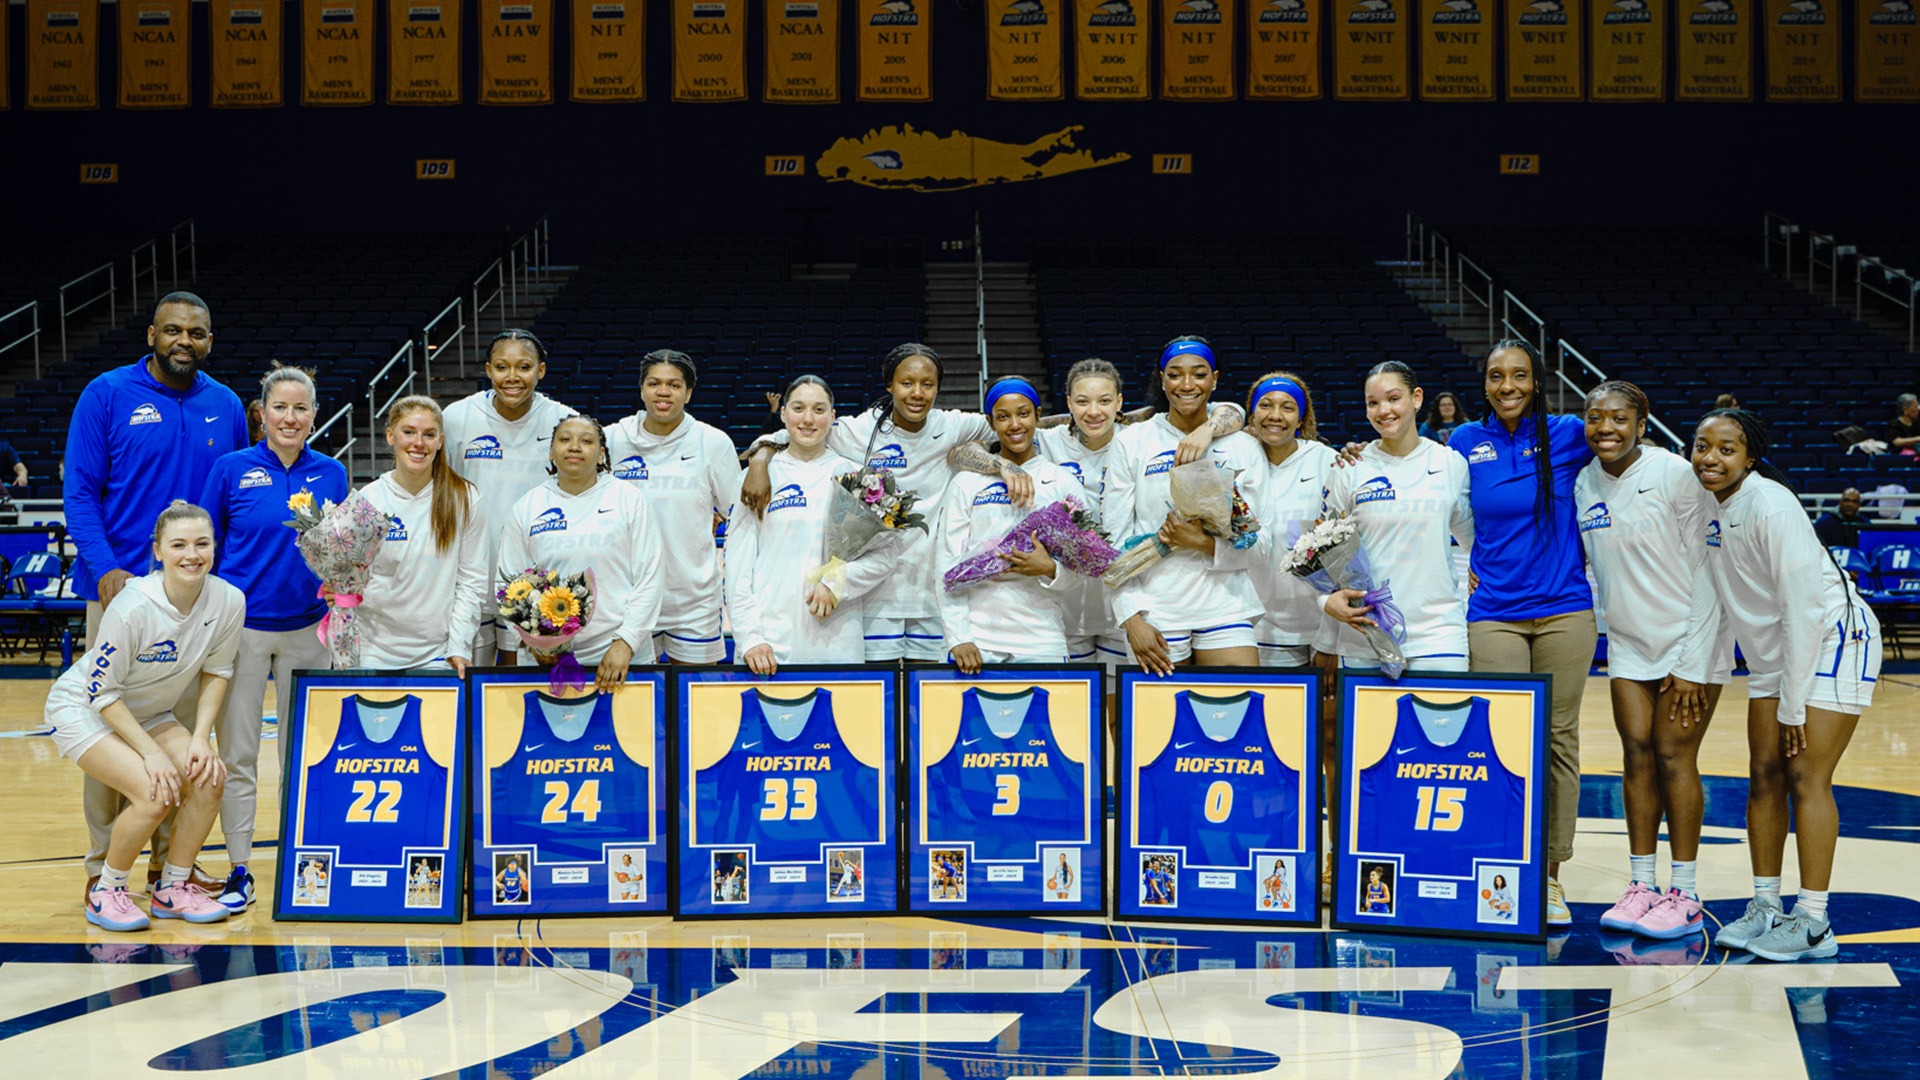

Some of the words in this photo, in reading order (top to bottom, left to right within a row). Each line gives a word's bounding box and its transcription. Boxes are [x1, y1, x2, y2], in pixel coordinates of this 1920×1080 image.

[872, 14, 917, 23] HOFSTRA
[1003, 14, 1047, 23] HOFSTRA
[1091, 15, 1135, 23] HOFSTRA
[1176, 12, 1221, 21] HOFSTRA
[1263, 12, 1307, 20] HOFSTRA
[1351, 12, 1396, 21] HOFSTRA
[1435, 12, 1480, 21] HOFSTRA
[1522, 13, 1567, 22] HOFSTRA
[1605, 12, 1650, 21] HOFSTRA
[1692, 12, 1736, 21] HOFSTRA
[1781, 13, 1825, 21] HOFSTRA
[1871, 13, 1916, 21] HOFSTRA
[317, 28, 359, 40] NCAA
[403, 27, 445, 38] NCAA
[492, 25, 540, 37] AIAW
[591, 25, 626, 36] NIT
[688, 23, 731, 34] NCAA
[780, 24, 823, 35] NCAA
[42, 32, 83, 44] NCAA
[133, 32, 175, 43] NCAA
[226, 29, 267, 41] NCAA
[879, 33, 911, 44] NIT
[1010, 32, 1040, 44] NIT
[1089, 33, 1137, 44] WNIT
[1182, 32, 1215, 44] NIT
[1258, 31, 1310, 43] WNIT
[1349, 32, 1395, 43] WNIT
[1435, 32, 1479, 44] WNIT
[1521, 32, 1567, 43] WNIT
[1612, 32, 1644, 44] NIT
[1693, 32, 1739, 44] WNIT
[1787, 33, 1821, 45] NIT
[1877, 33, 1910, 45] NIT
[328, 55, 348, 63] 1976
[698, 54, 723, 62] 2000
[792, 52, 812, 61] 2001
[884, 56, 905, 64] 2005
[1013, 56, 1038, 64] 2006
[1101, 56, 1125, 64] 2006
[1188, 55, 1209, 64] 2007
[1274, 54, 1296, 63] 2007
[323, 80, 352, 88] MEN'S
[495, 78, 538, 87] WOMEN'S
[593, 76, 623, 84] MEN'S
[693, 78, 727, 86] MEN'S
[140, 83, 169, 91] MEN'S
[232, 82, 260, 90] MEN'S
[578, 87, 636, 96] BASKETBALL
[865, 87, 922, 95] BASKETBALL
[998, 85, 1055, 93] BASKETBALL
[1084, 86, 1139, 94] BASKETBALL
[1167, 85, 1225, 94] BASKETBALL
[126, 93, 181, 102] BASKETBALL
[308, 90, 367, 99] BASKETBALL
[395, 90, 452, 98] BASKETBALL
[487, 90, 545, 98] BASKETBALL
[680, 89, 737, 97] BASKETBALL
[771, 88, 832, 97] BASKETBALL
[421, 162, 449, 176] 109
[773, 160, 797, 172] 110
[1162, 158, 1183, 171] 111
[1508, 158, 1532, 171] 112
[86, 166, 112, 180] 108
[1147, 463, 1173, 472] HOFST
[1357, 490, 1394, 502] HOFSTRA
[770, 498, 805, 510] HOFSTRA
[531, 520, 566, 533] HOFSTRA
[386, 531, 406, 539] STRA
[25, 554, 49, 572] H
[1832, 549, 1850, 568] H
[1892, 550, 1911, 569] H
[138, 652, 176, 662] HOFSTRA
[1028, 739, 1046, 747] CAA
[1244, 746, 1262, 754] CAA
[1468, 751, 1486, 759] CAA
[334, 758, 420, 774] HOFSTRA
[526, 757, 615, 775] HOFSTRA
[746, 756, 832, 772] HOFSTRA
[962, 753, 1049, 768] HOFSTRA
[1175, 757, 1265, 776] HOFSTRA
[1396, 763, 1489, 782] HOFSTRA
[760, 777, 817, 821] 33
[992, 774, 1021, 817] 3
[345, 780, 402, 823] 22
[541, 779, 602, 824] 24
[1204, 780, 1234, 824] 0
[1414, 786, 1468, 832] 15
[0, 963, 1900, 1080] OFST
